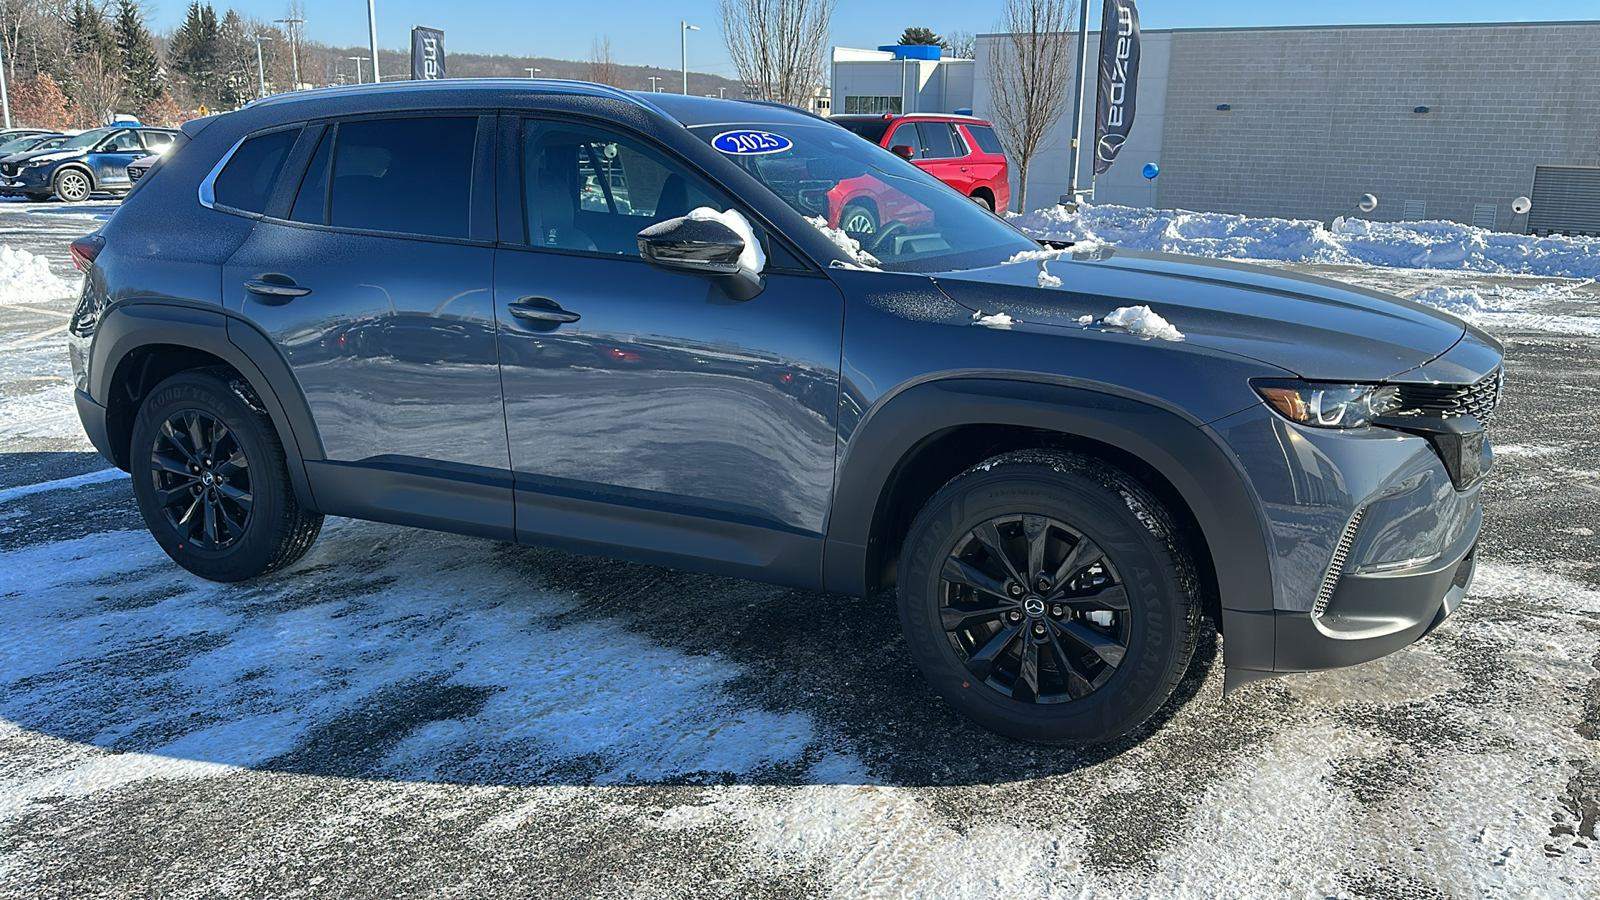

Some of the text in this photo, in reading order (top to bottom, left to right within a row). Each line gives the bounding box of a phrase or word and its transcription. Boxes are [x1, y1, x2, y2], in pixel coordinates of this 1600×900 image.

[1109, 6, 1133, 127] mazda
[727, 133, 779, 153] 2025
[1121, 566, 1163, 706] ASSURANCE
